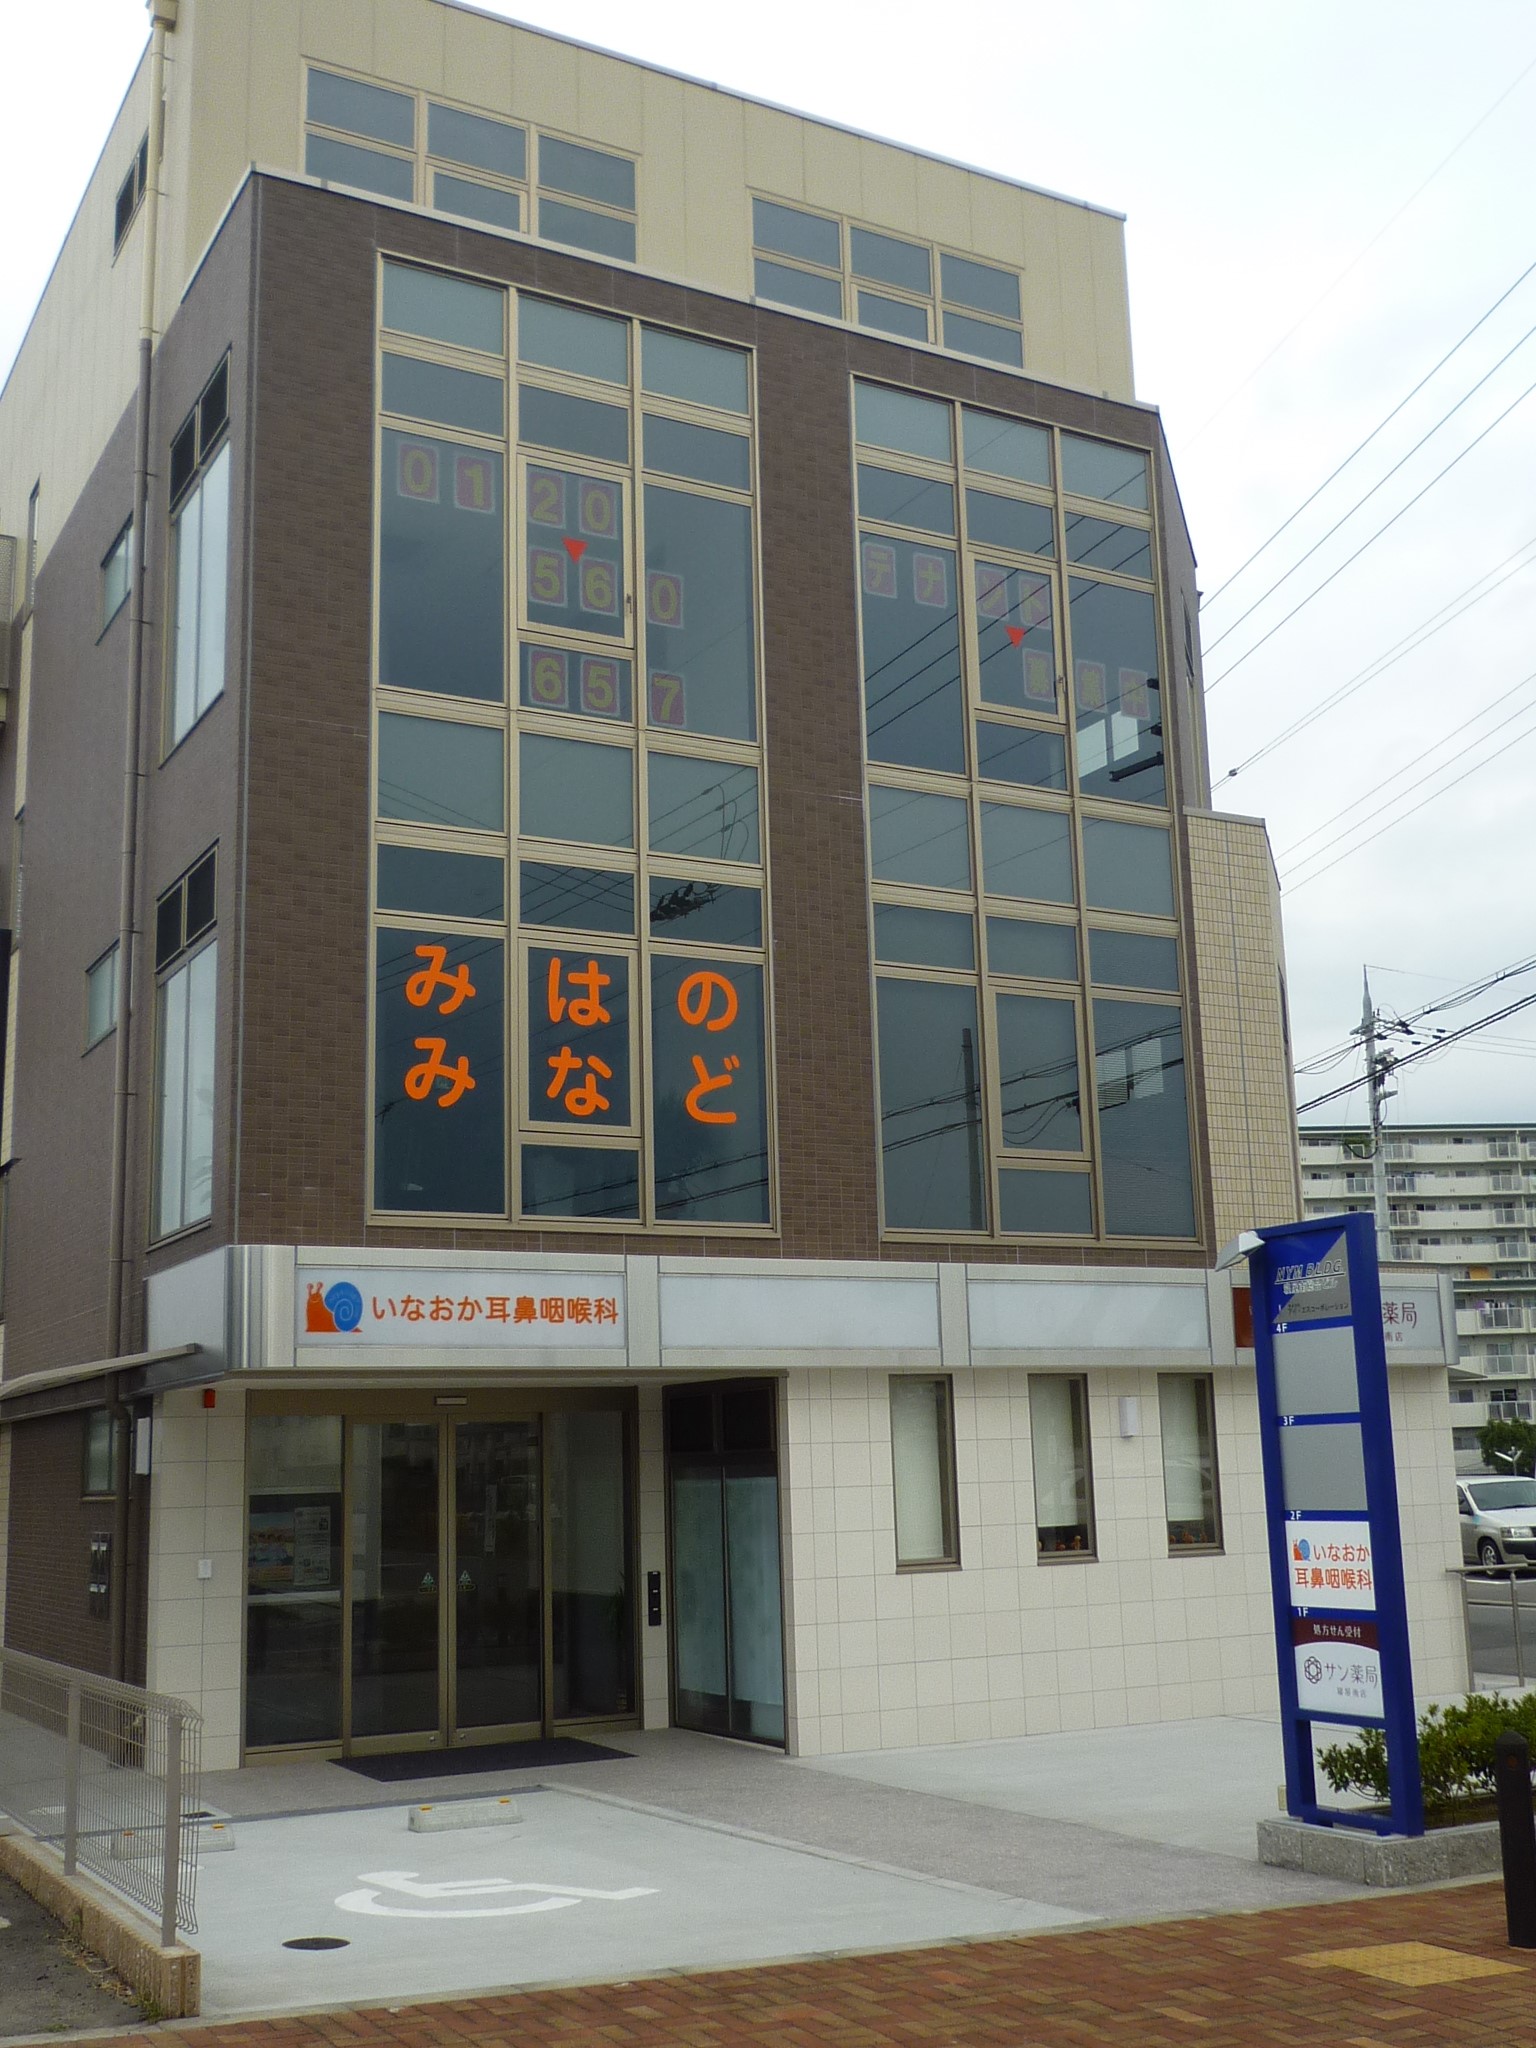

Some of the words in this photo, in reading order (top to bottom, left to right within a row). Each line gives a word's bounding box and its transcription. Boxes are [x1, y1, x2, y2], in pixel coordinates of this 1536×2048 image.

[402, 447, 612, 534] 0120
[532, 554, 680, 621] 560
[865, 550, 1046, 624] テナント
[533, 656, 681, 721] 657
[405, 945, 476, 1108] みみ
[546, 957, 613, 1117] はな
[677, 971, 740, 1124] のど
[371, 1294, 619, 1325] いなおか耳鼻咽喉科
[1276, 1323, 1288, 1333] 4F
[1283, 1416, 1295, 1426] 3F
[1290, 1511, 1302, 1520] 2F
[1313, 1543, 1370, 1563] いなおか
[1295, 1567, 1372, 1591] 耳鼻咽喉科
[1297, 1607, 1309, 1617] 1F
[1313, 1623, 1362, 1639] 処方せん受付
[1324, 1662, 1379, 1689] サン薬局
